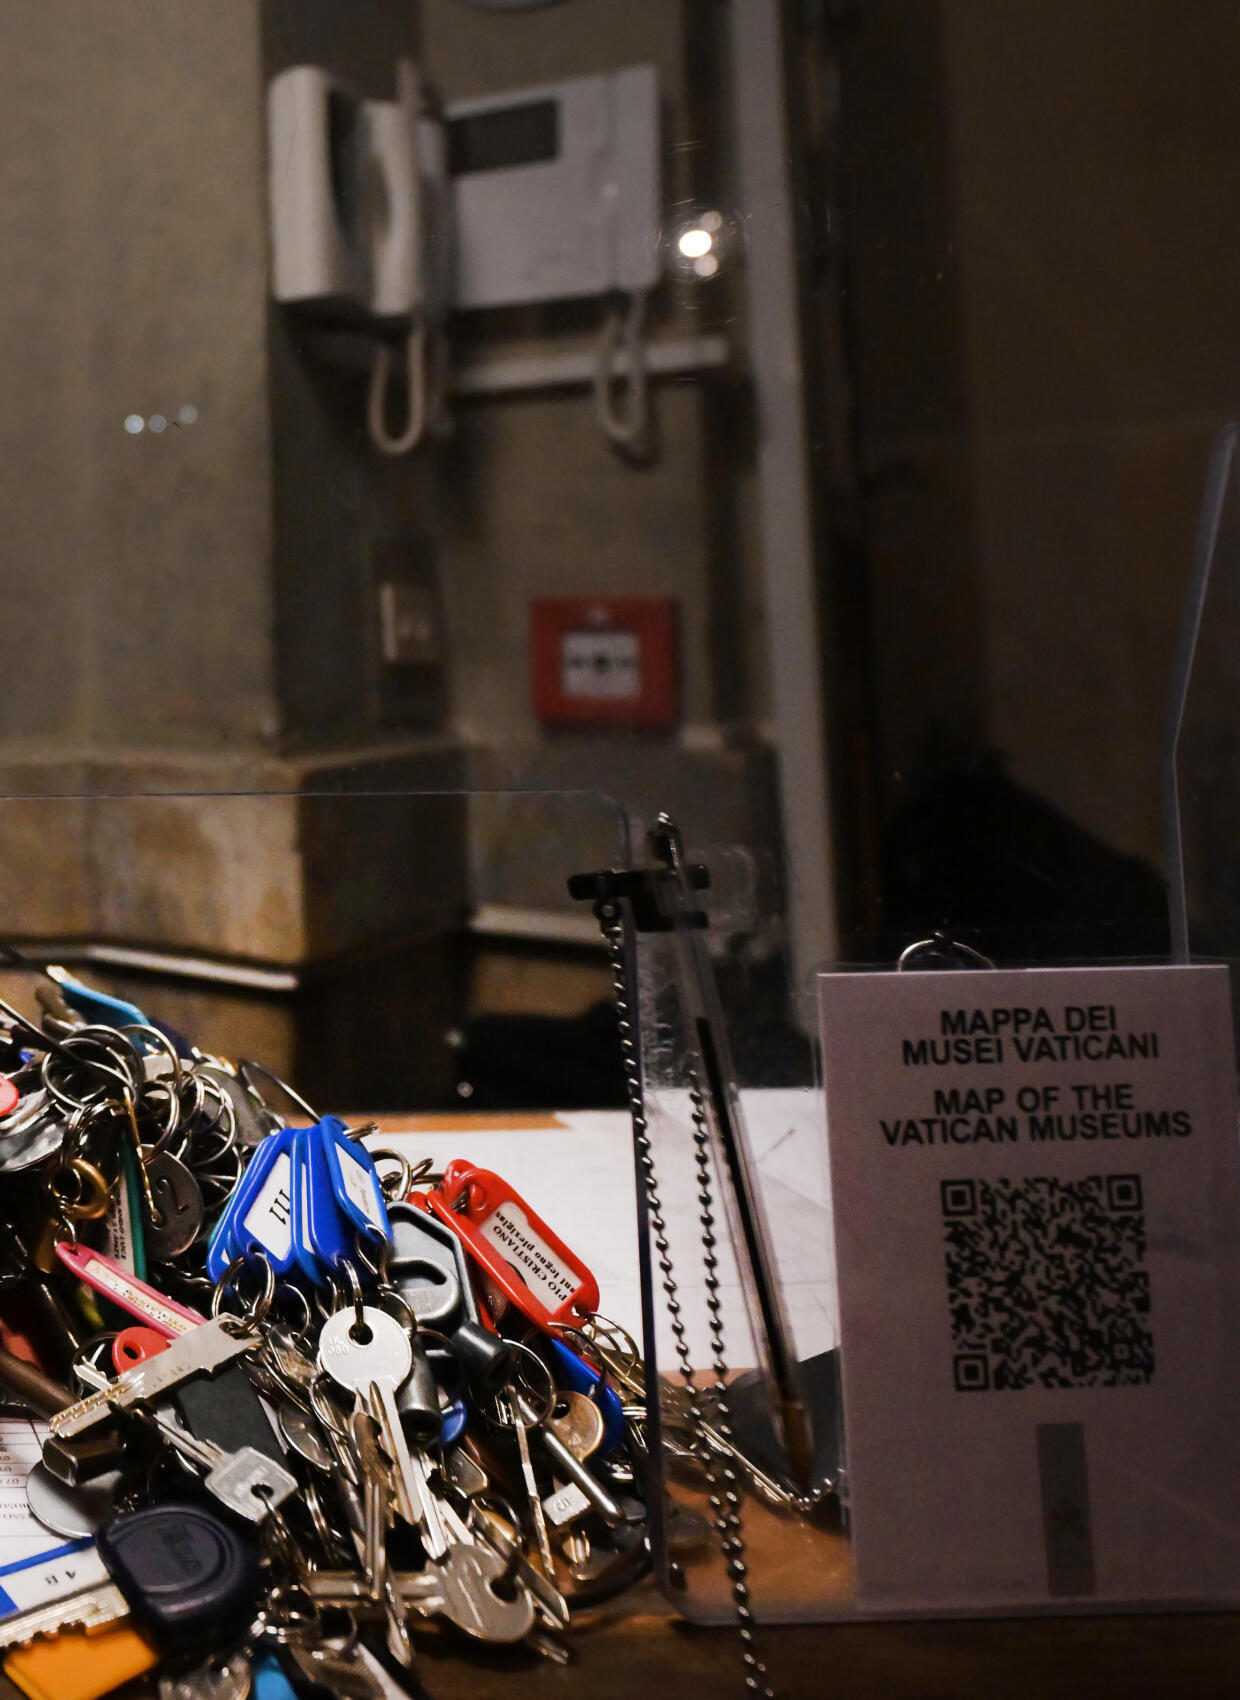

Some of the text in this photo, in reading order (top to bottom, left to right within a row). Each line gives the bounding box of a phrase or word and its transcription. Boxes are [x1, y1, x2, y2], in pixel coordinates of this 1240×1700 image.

[941, 1005, 1115, 1036] MAPPA DEI
[902, 1033, 1158, 1066] MUSEI VATICANI
[935, 1084, 1133, 1115] MAP OF THE
[880, 1111, 1192, 1146] VATICAN MUSEUMS
[492, 1224, 567, 1301] PIO CRISTIANO
[532, 1251, 559, 1278] legno
